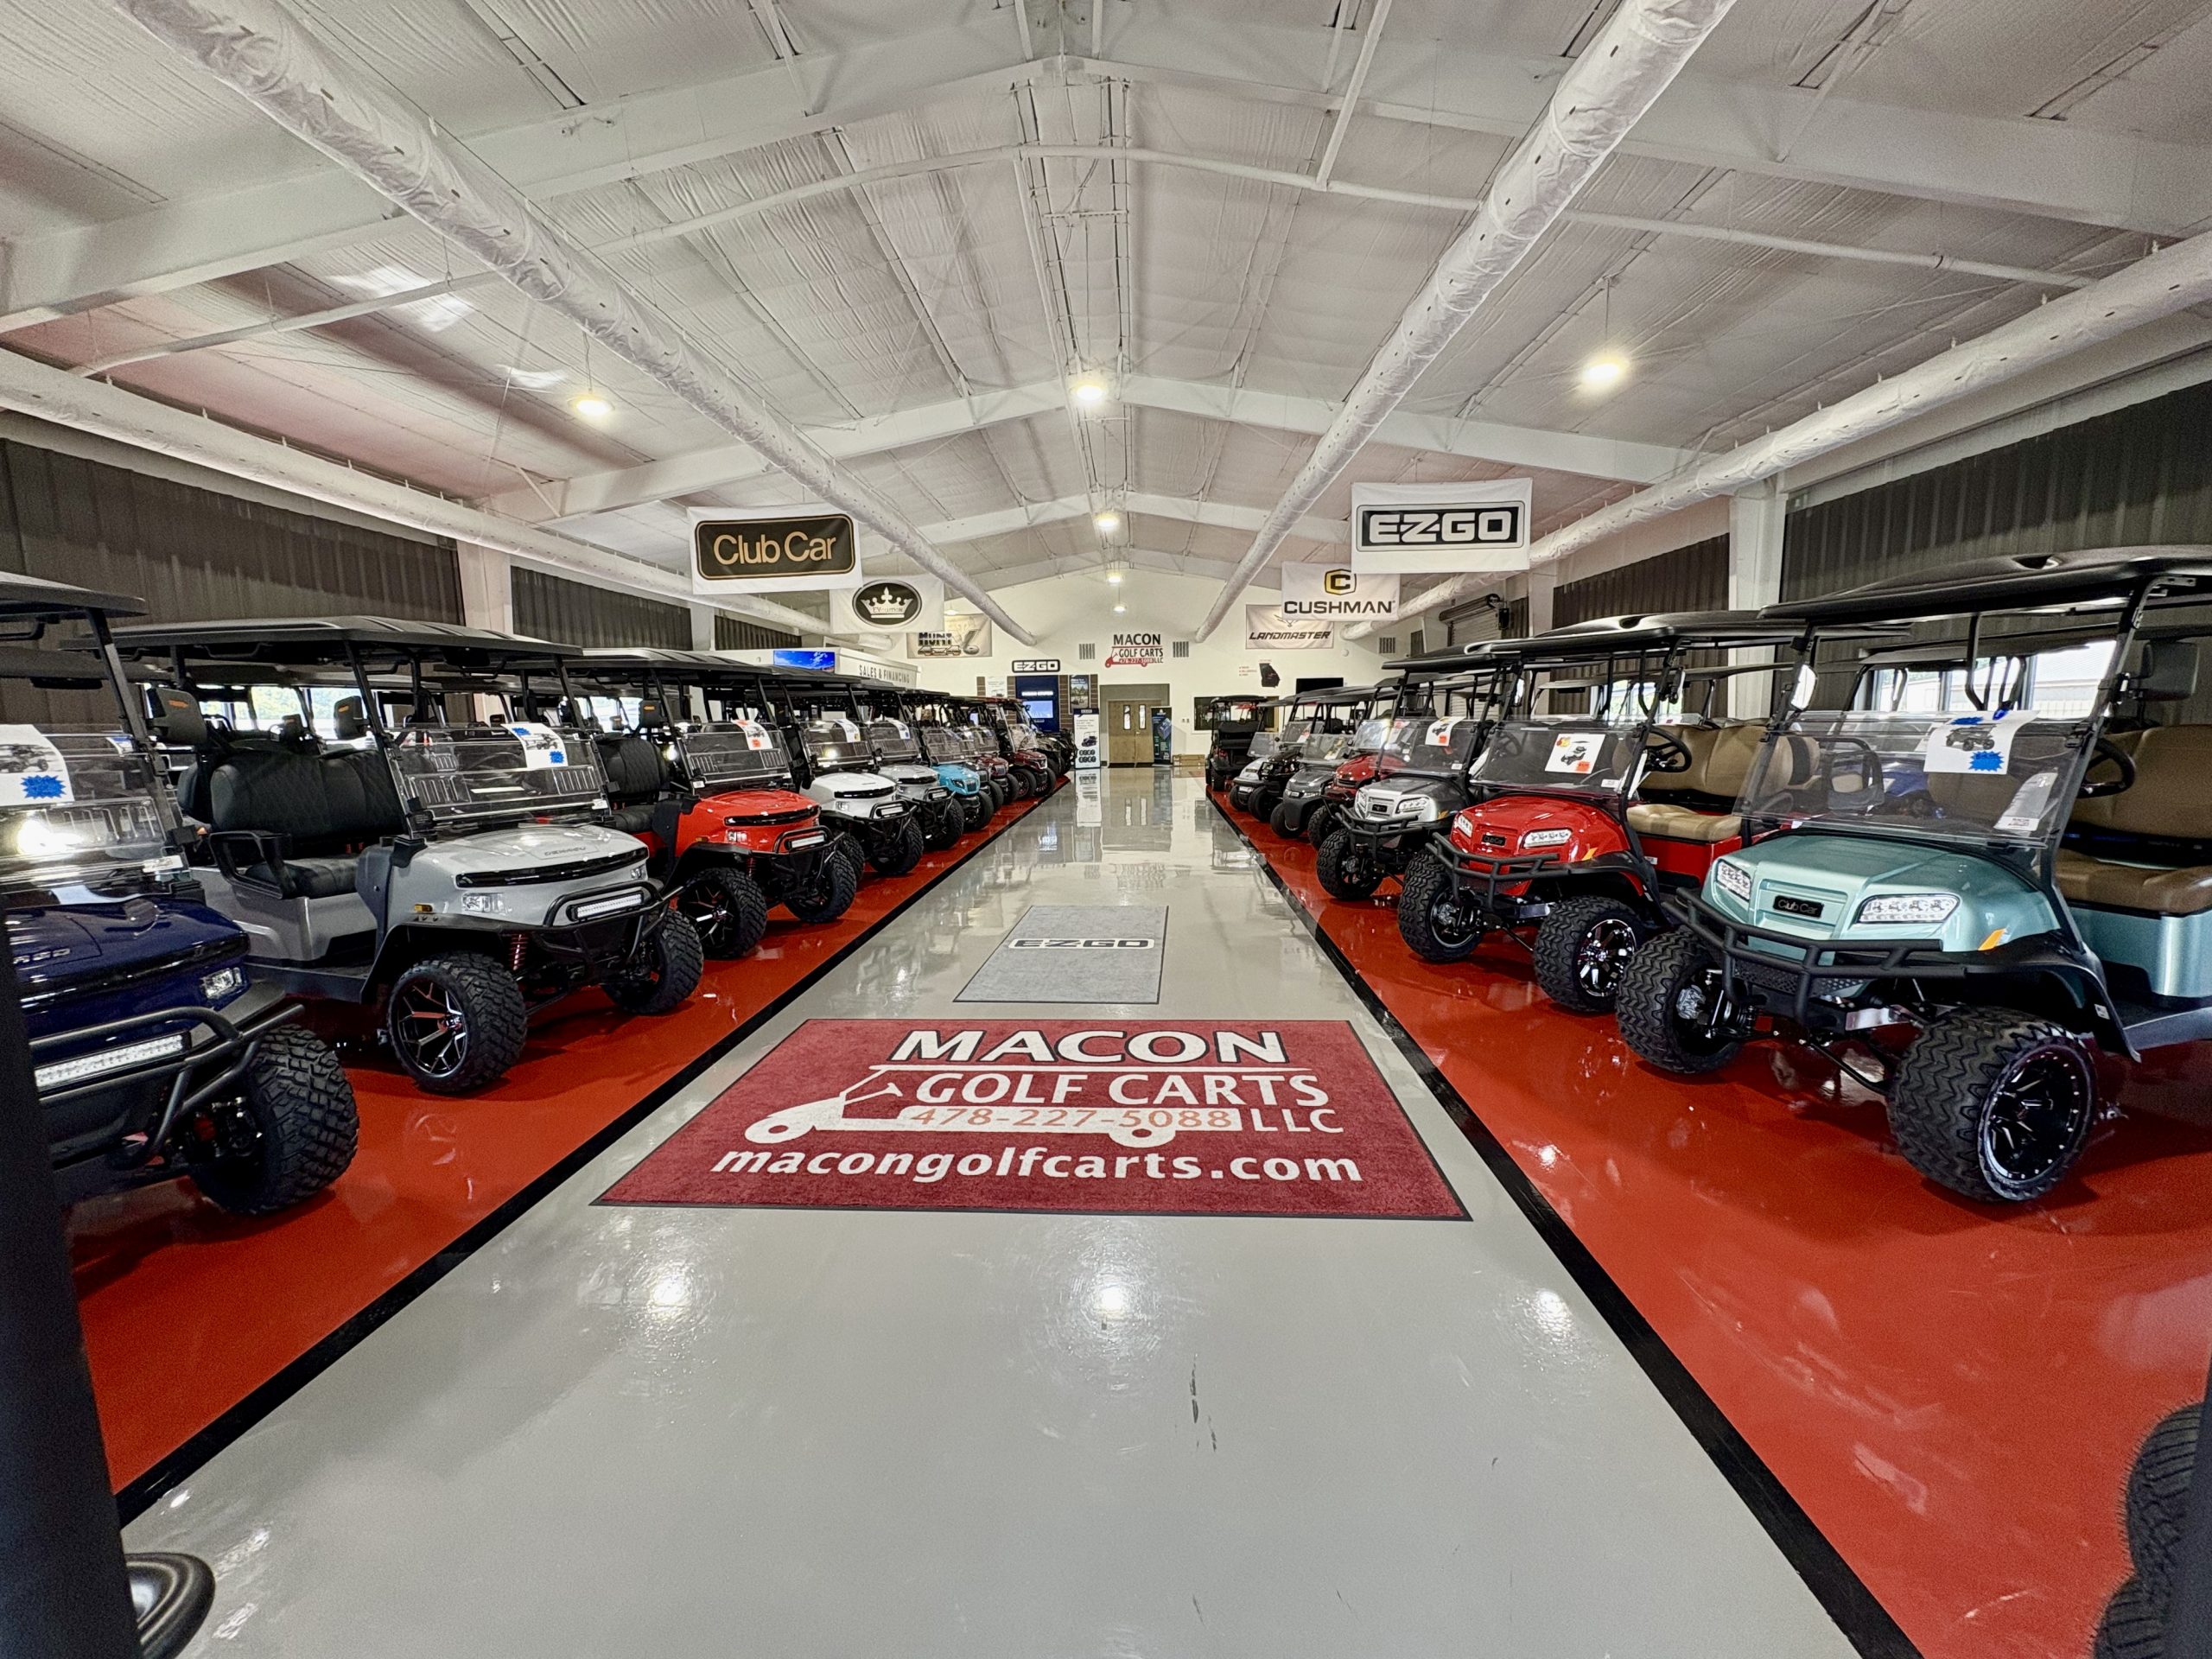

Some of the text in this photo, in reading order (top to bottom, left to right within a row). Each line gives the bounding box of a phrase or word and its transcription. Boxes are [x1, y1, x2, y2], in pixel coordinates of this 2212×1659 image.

[713, 531, 836, 565] Club Car
[1284, 600, 1392, 614] CUSHMAN
[1113, 633, 1161, 645] MACON
[1249, 631, 1332, 641] LANDMASTER
[1119, 648, 1164, 658] GOLF CARTS
[859, 664, 910, 683] SALES & FINANCING
[1777, 899, 1818, 914] Club Car
[888, 1029, 1290, 1064] MACON
[916, 1072, 1330, 1107] GOLF CARTS
[910, 1108, 1344, 1133] 478-227-5088 LLC
[710, 1147, 1363, 1184] macongolfcarts.com
